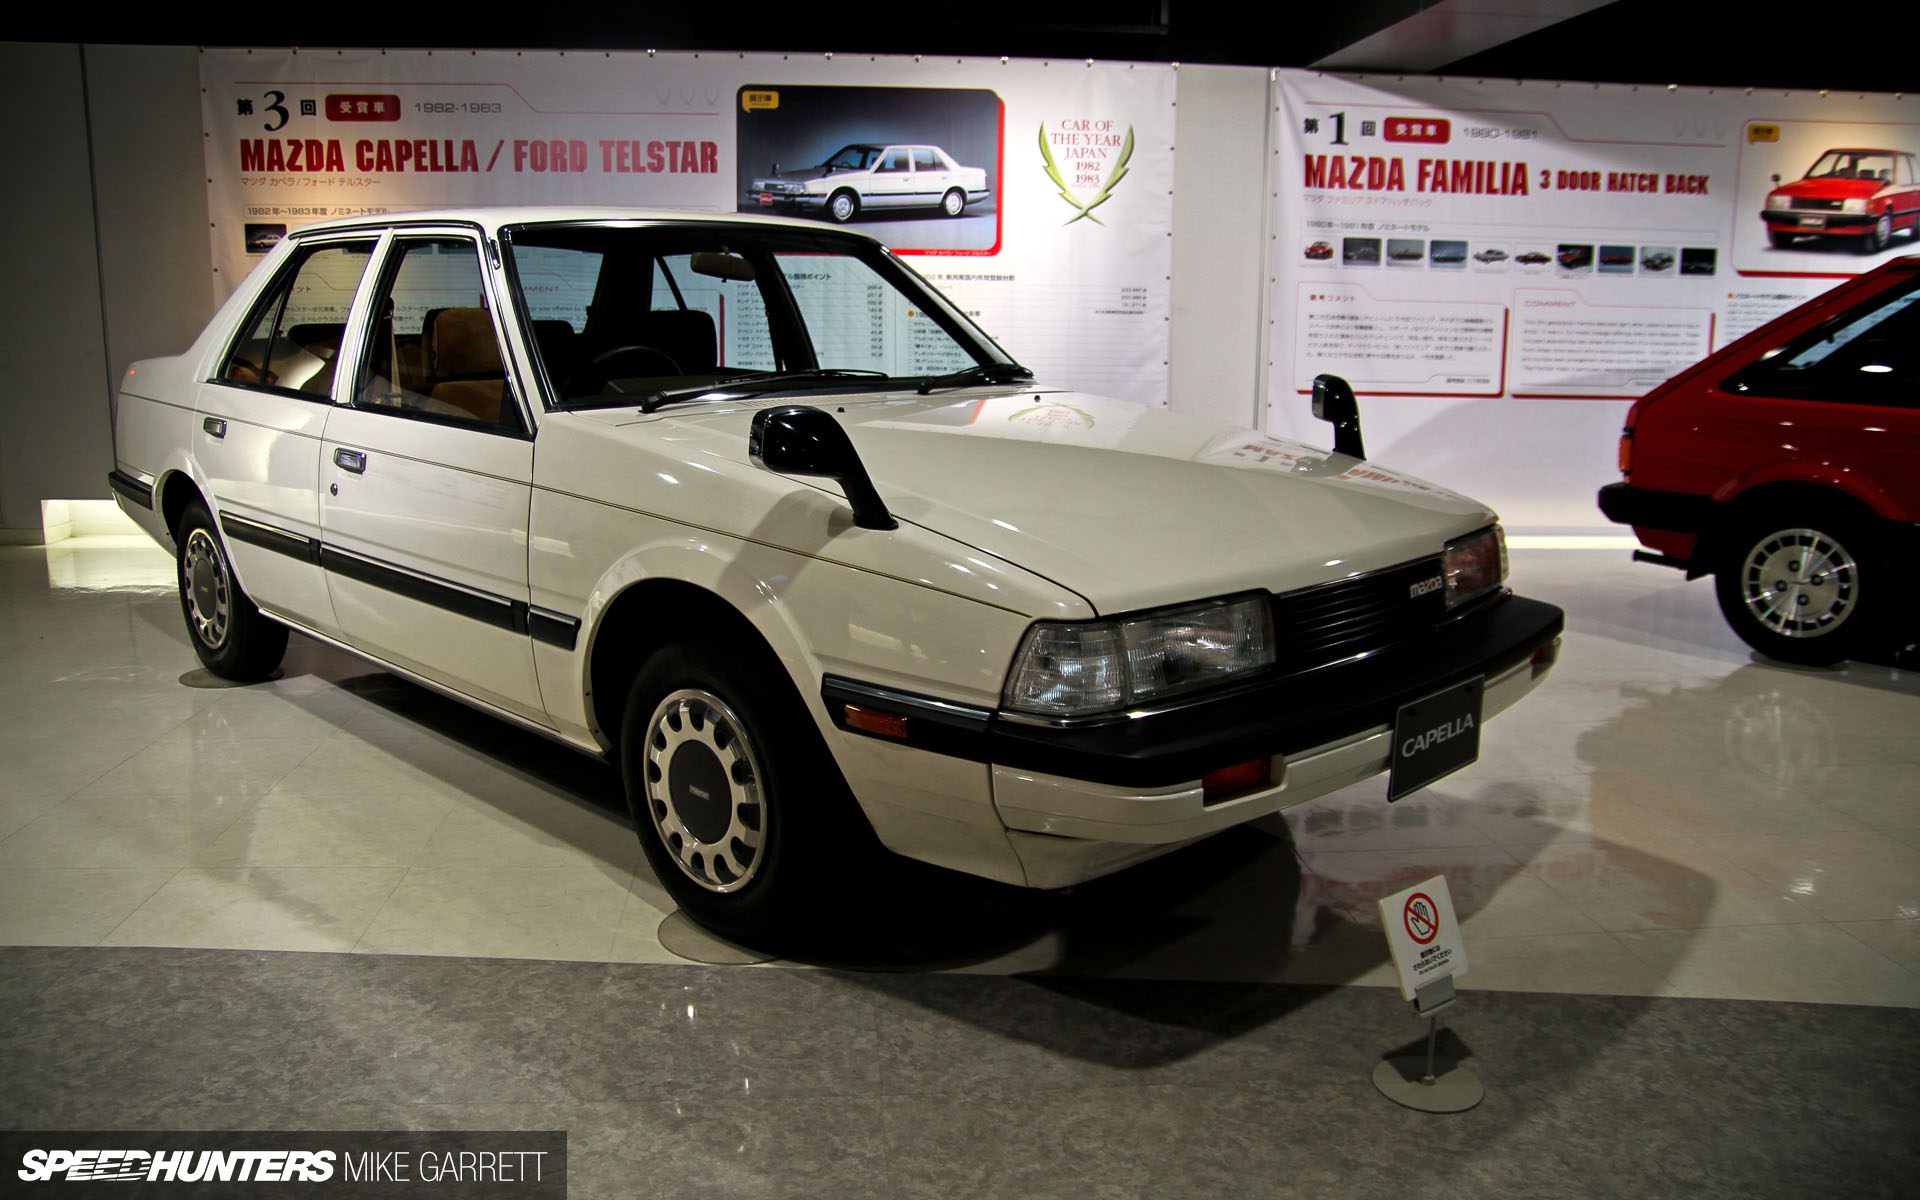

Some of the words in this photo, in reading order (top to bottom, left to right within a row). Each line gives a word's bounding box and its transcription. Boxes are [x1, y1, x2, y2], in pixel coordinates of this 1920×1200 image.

[339, 102, 386, 114] 受賞車
[415, 103, 502, 113] 1982-1983
[1061, 119, 1090, 131] CAR
[1095, 120, 1113, 132] OF
[1395, 124, 1438, 137] 受賞車
[1051, 133, 1080, 145] THE
[1082, 134, 1121, 146] YEAR
[240, 139, 345, 172] MAZDA
[355, 139, 479, 172] CAPELLA
[486, 139, 505, 172] /
[514, 139, 588, 173] FORD
[599, 140, 718, 173] TELSTAR
[1064, 147, 1107, 160] JAPAN
[1076, 161, 1101, 171] 1982
[1075, 174, 1100, 184] 1983
[1304, 154, 1405, 191] MAZDA
[1417, 158, 1529, 196] FAMILIA
[1539, 170, 1551, 190] 3
[1556, 169, 1601, 192] DOOR
[1607, 172, 1660, 193] HATCH
[1664, 174, 1711, 195] BACK
[240, 177, 267, 187] マツダ
[338, 177, 381, 187] テルスター
[1409, 575, 1443, 599] mazda
[1402, 713, 1474, 758] CAPELLA
